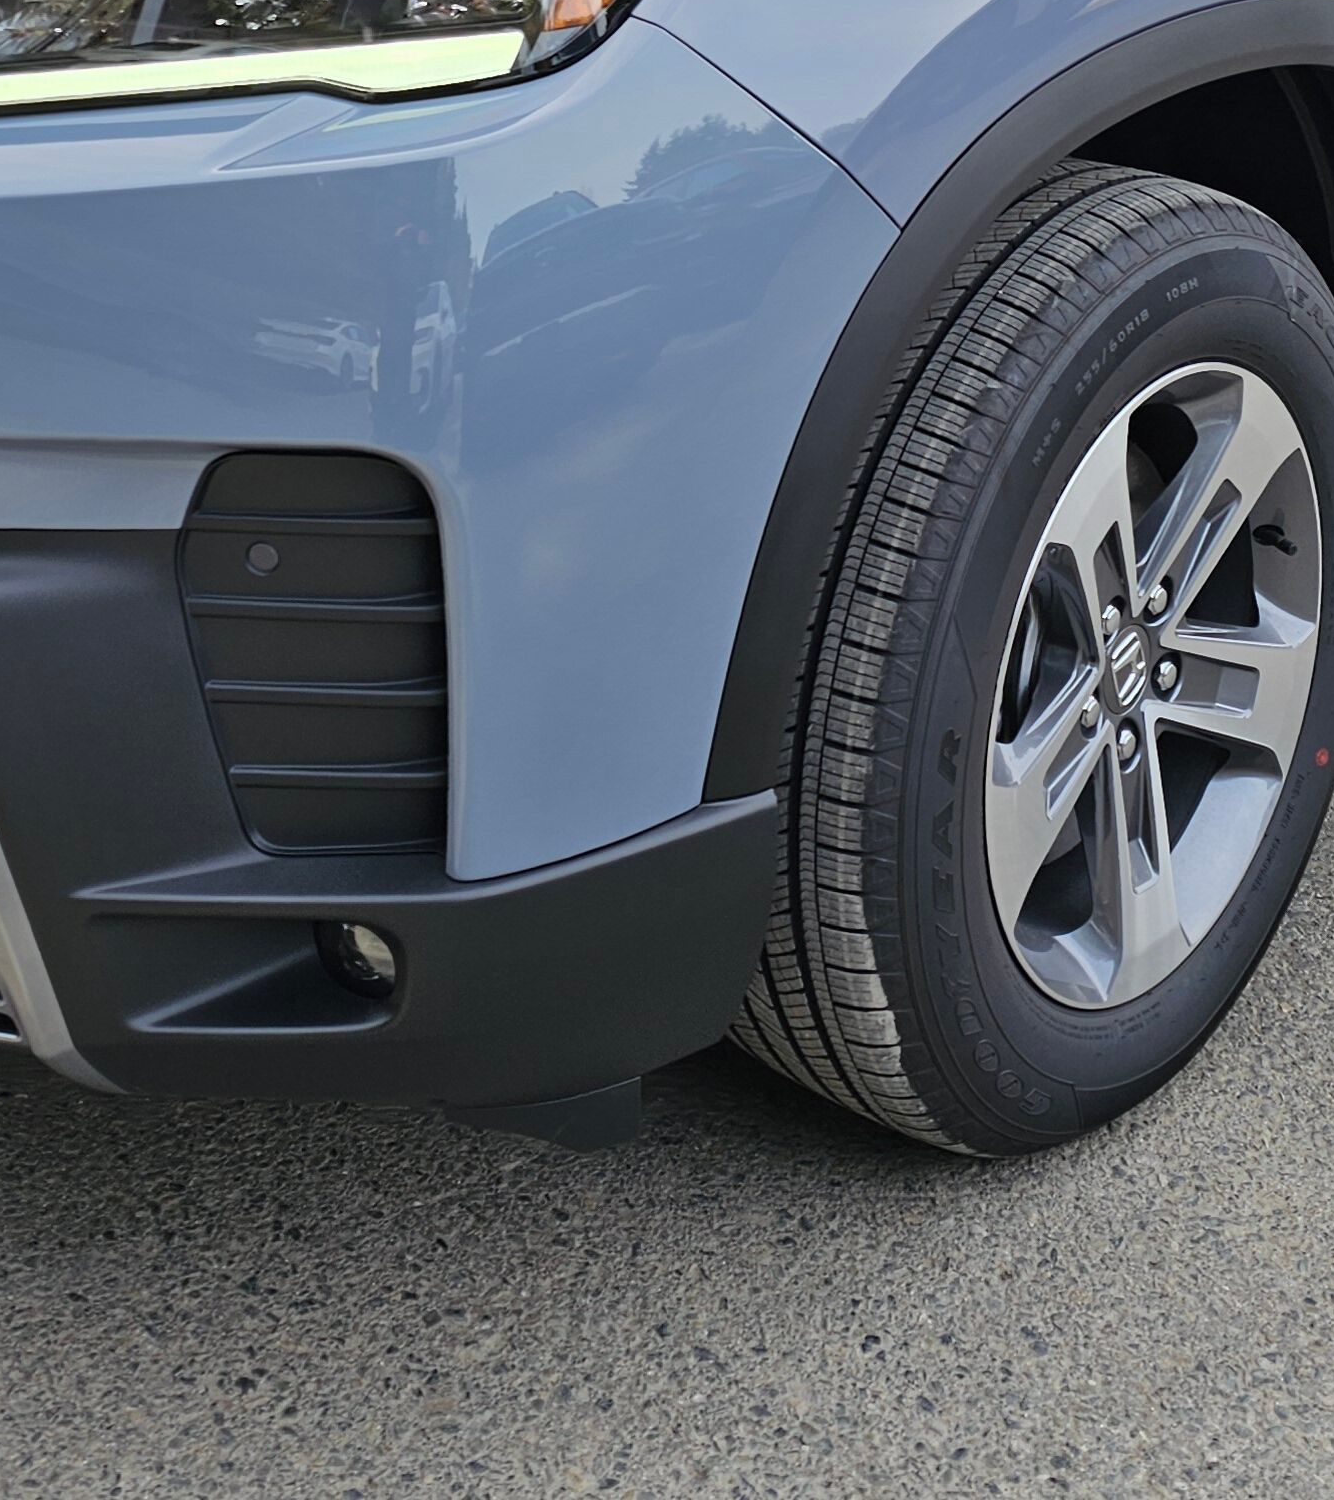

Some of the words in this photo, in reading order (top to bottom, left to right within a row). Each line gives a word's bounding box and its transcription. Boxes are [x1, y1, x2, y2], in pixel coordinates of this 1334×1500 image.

[1165, 276, 1200, 303] 108H
[1074, 307, 1151, 397] 255/60R18
[1031, 417, 1062, 468] M+S
